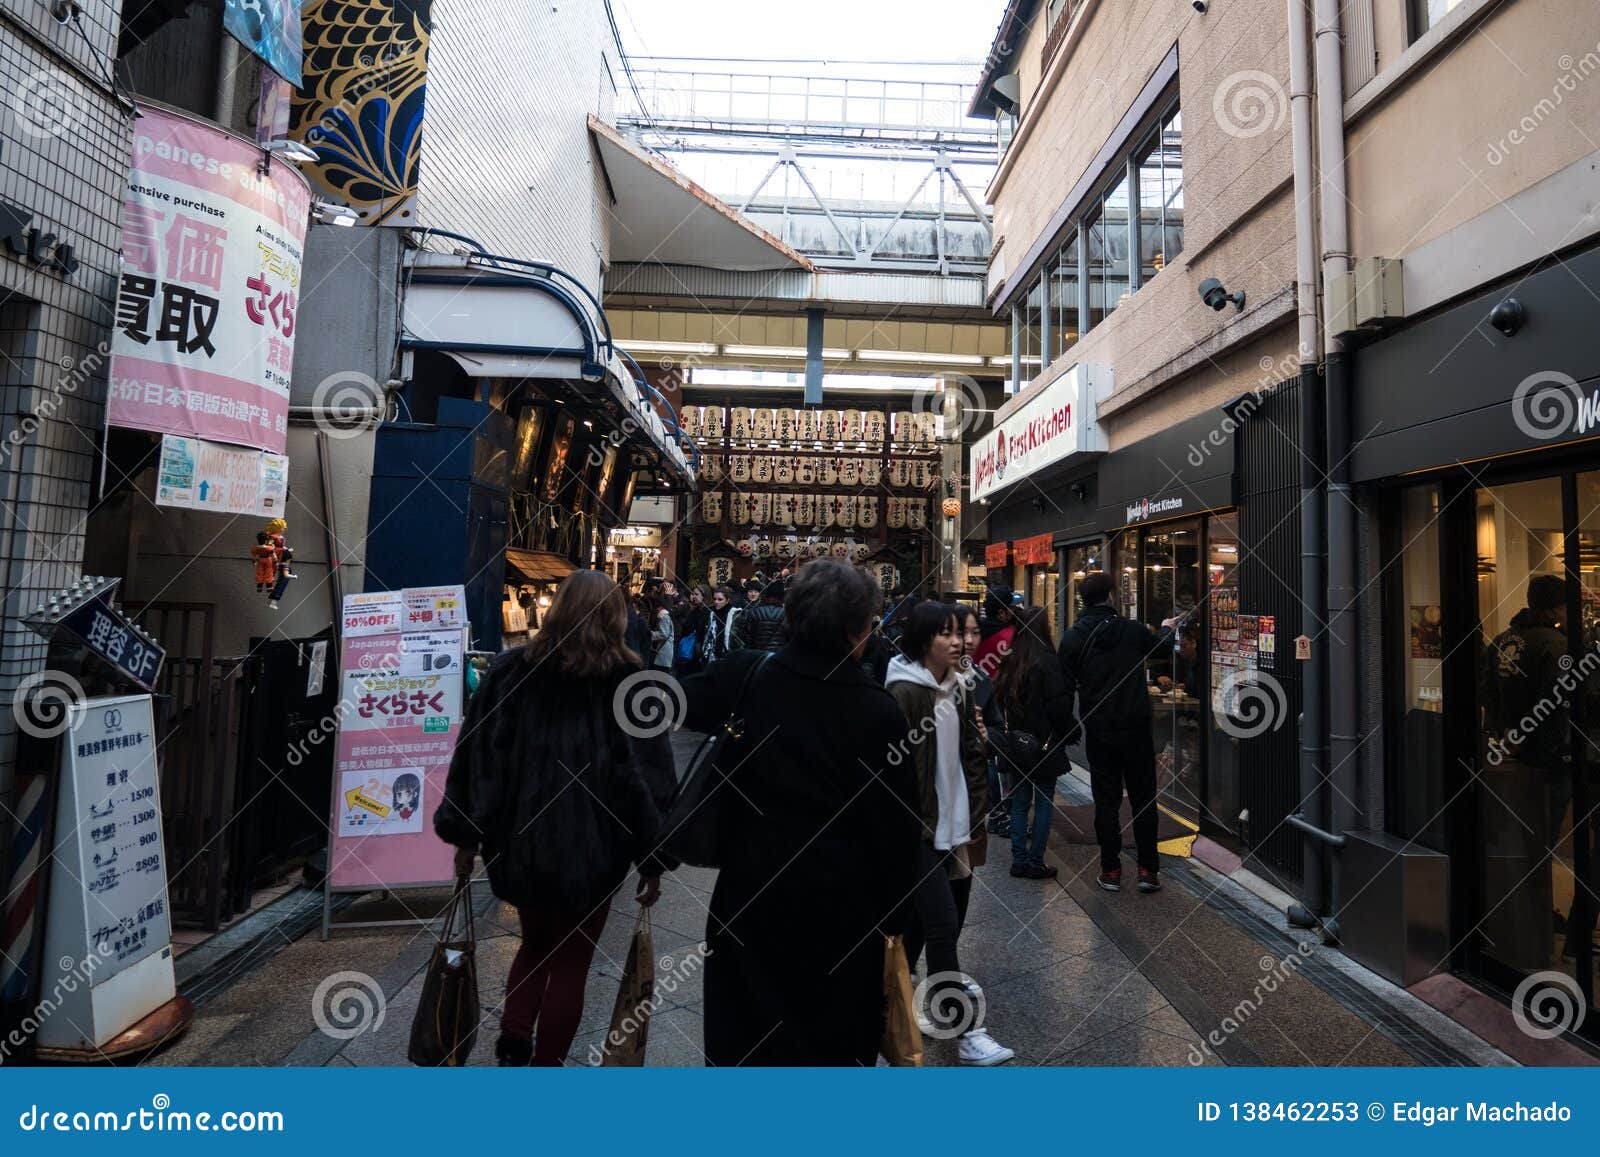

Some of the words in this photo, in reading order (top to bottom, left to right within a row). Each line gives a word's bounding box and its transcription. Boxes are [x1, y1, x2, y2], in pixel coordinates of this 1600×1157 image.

[134, 134, 233, 179] panese
[127, 182, 171, 202] ensive
[173, 195, 226, 219] purchase
[1028, 403, 1071, 450] Kitchen
[1161, 498, 1182, 511] Kitchen
[344, 614, 395, 628] 50%OFF!
[87, 611, 128, 662] 理容
[128, 643, 156, 678] 3F
[349, 640, 397, 650] Japanese
[358, 690, 444, 718] さくらさく
[133, 809, 155, 825] 1300
[140, 832, 157, 847] 900
[136, 854, 159, 872] 2800
